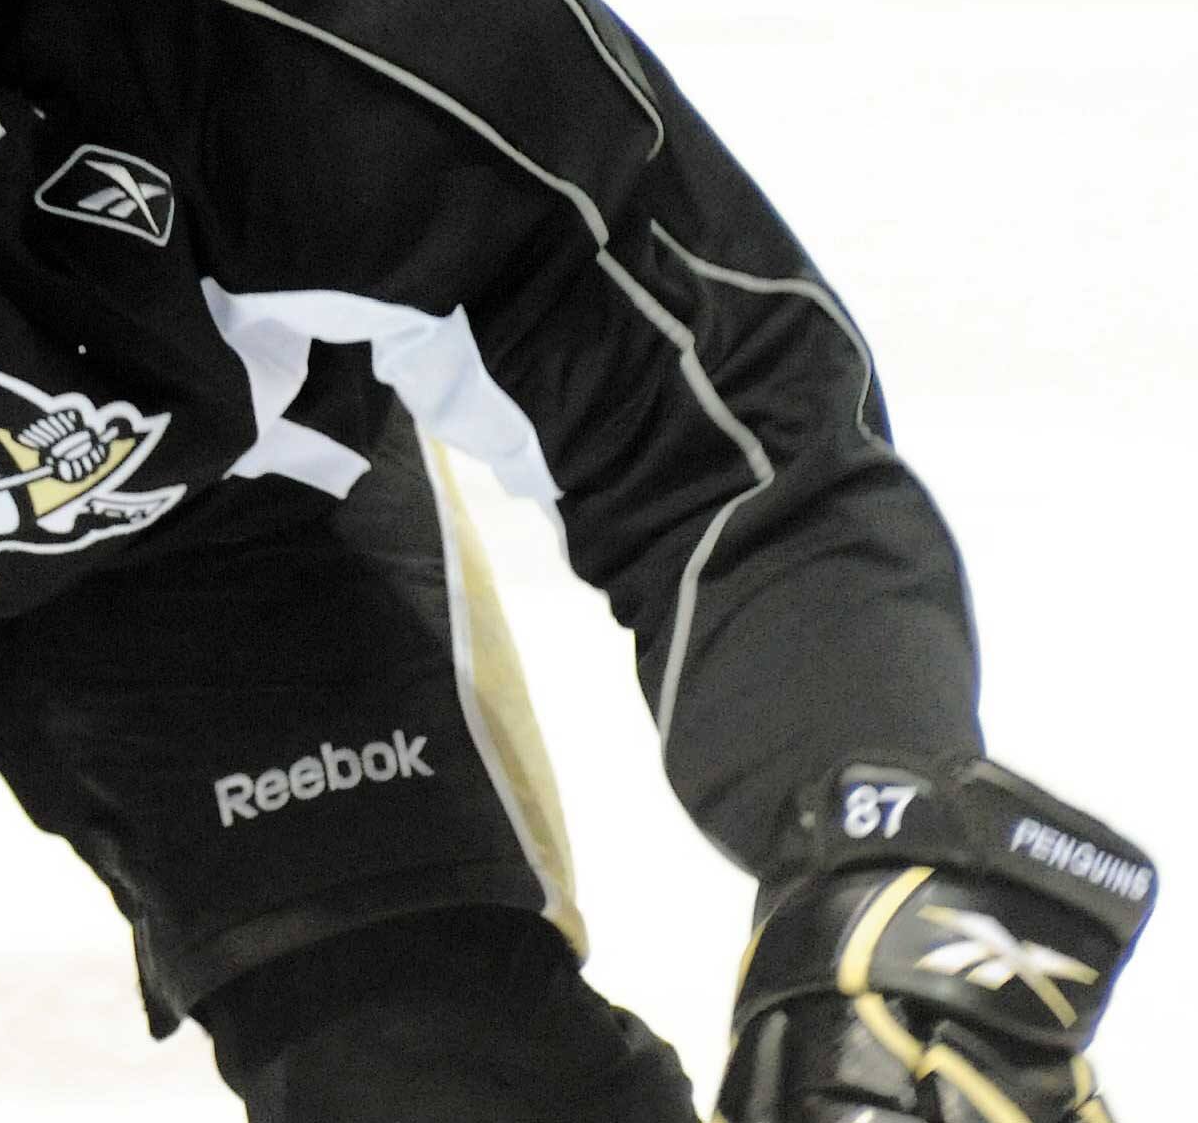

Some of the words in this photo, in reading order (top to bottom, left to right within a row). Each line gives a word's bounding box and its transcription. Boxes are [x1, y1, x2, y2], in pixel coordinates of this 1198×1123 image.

[214, 728, 436, 828] Reebok
[843, 784, 918, 840] 87
[1008, 816, 1153, 902] PENGUINS
